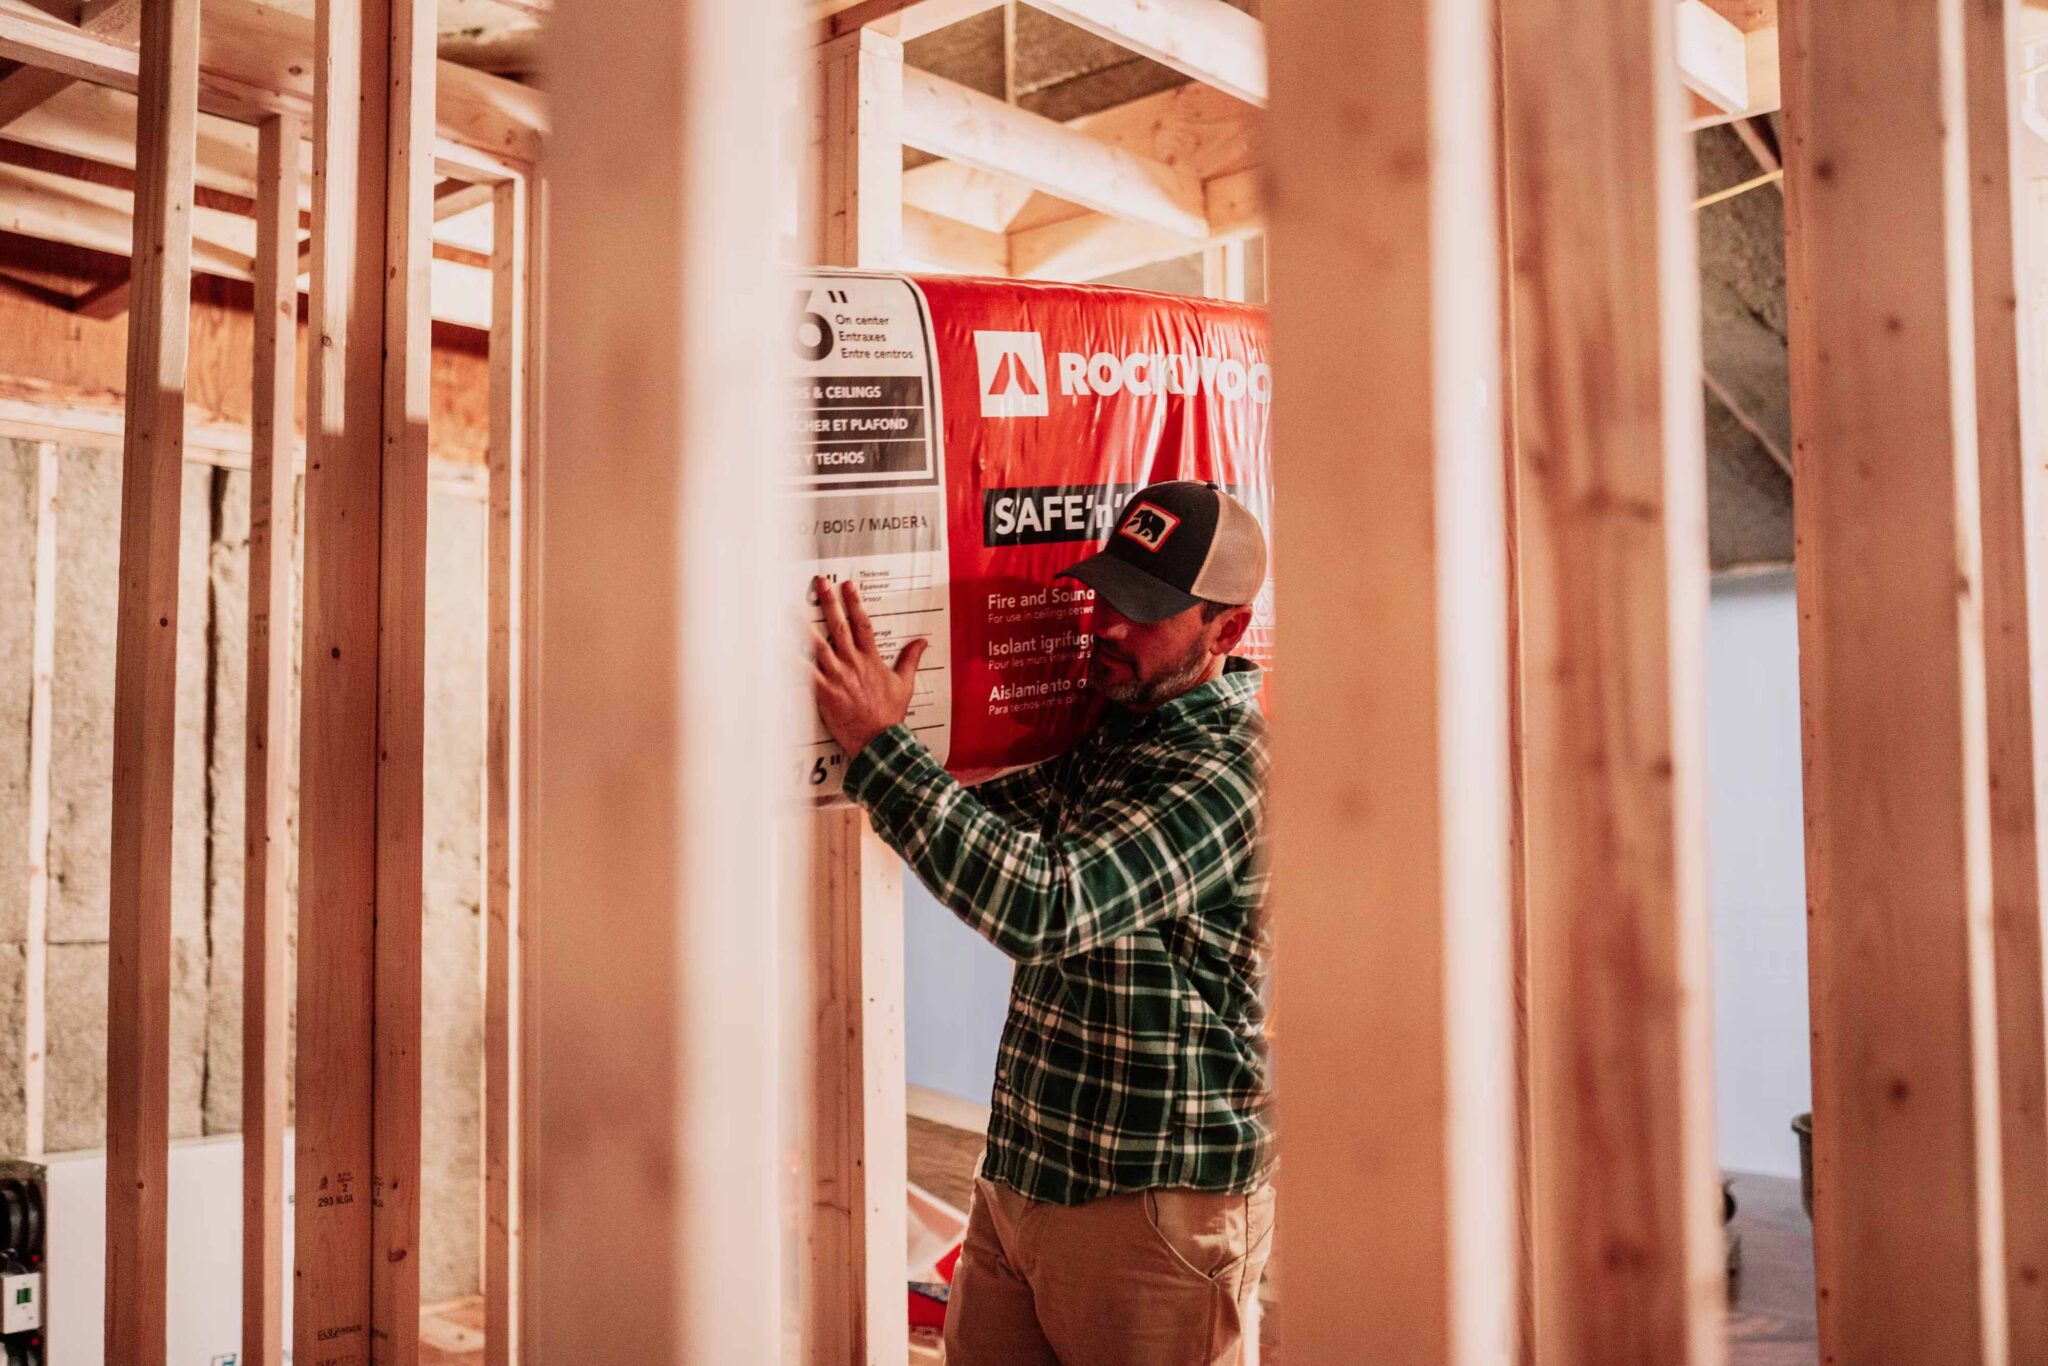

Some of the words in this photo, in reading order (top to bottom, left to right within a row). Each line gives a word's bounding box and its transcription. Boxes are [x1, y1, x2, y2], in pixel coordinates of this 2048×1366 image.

[835, 314, 852, 326] On
[855, 315, 889, 326] center
[839, 331, 886, 342] Entraxes
[841, 348, 870, 359] Entre
[874, 348, 913, 359] centros
[826, 385, 882, 399] CEILINGS
[833, 417, 848, 431] ET
[850, 417, 908, 431] PLAFOND
[815, 451, 865, 465] TECHOS
[823, 519, 855, 534] BOIS
[868, 515, 928, 531] MADERA
[988, 593, 1016, 609] Fire
[1020, 588, 1047, 606] and
[988, 613, 1004, 623] For
[988, 637, 1037, 656] Isolant
[988, 659, 1009, 670] Pour
[989, 679, 1072, 702] Aislamiento
[988, 705, 1009, 715] Para
